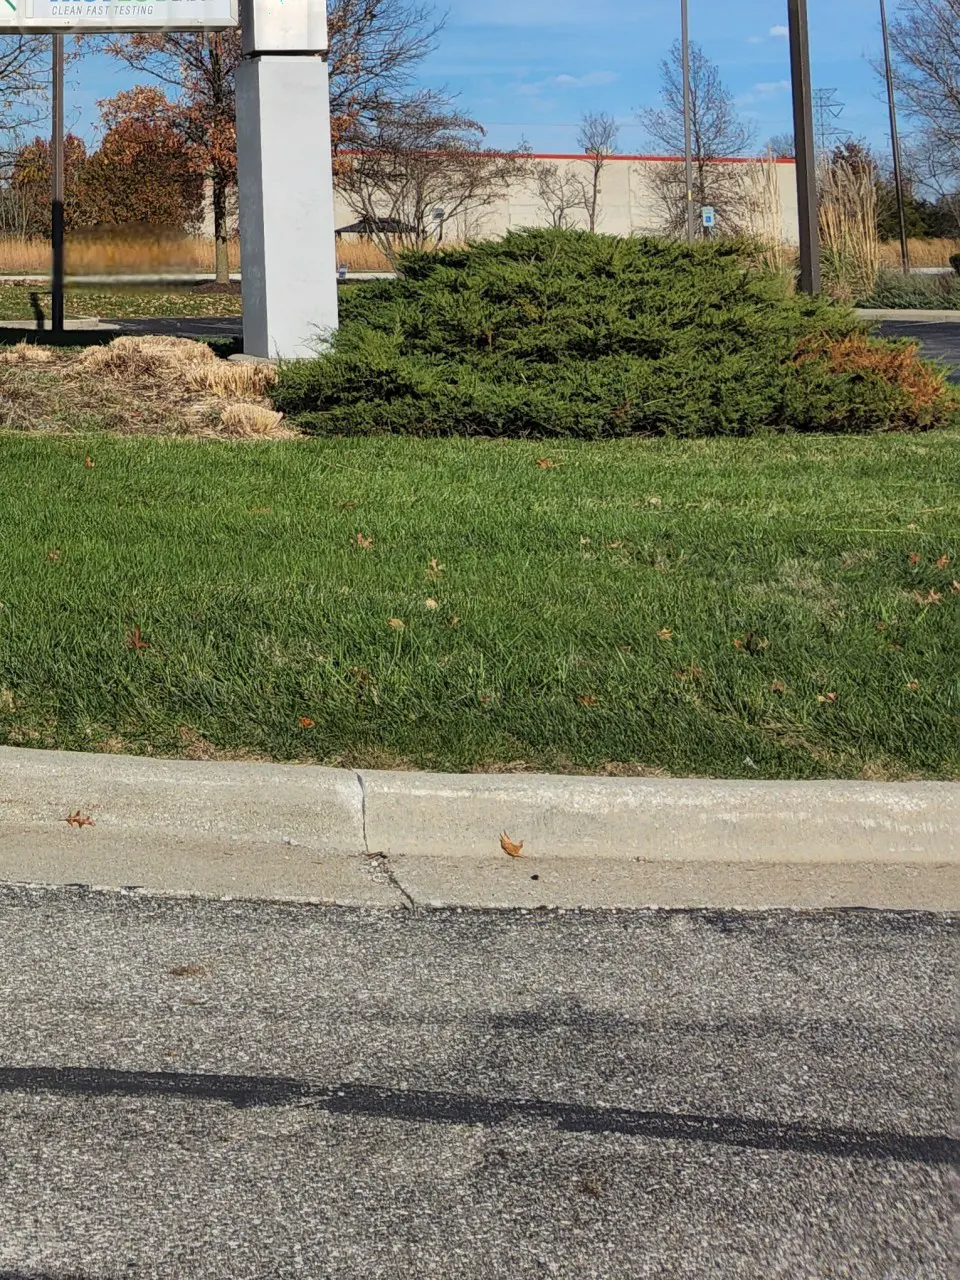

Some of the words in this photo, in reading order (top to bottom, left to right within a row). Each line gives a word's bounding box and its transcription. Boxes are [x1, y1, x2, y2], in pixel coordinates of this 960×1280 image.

[51, 5, 82, 15] CLEAN
[86, 5, 111, 15] FAST
[113, 5, 154, 15] TESTING
